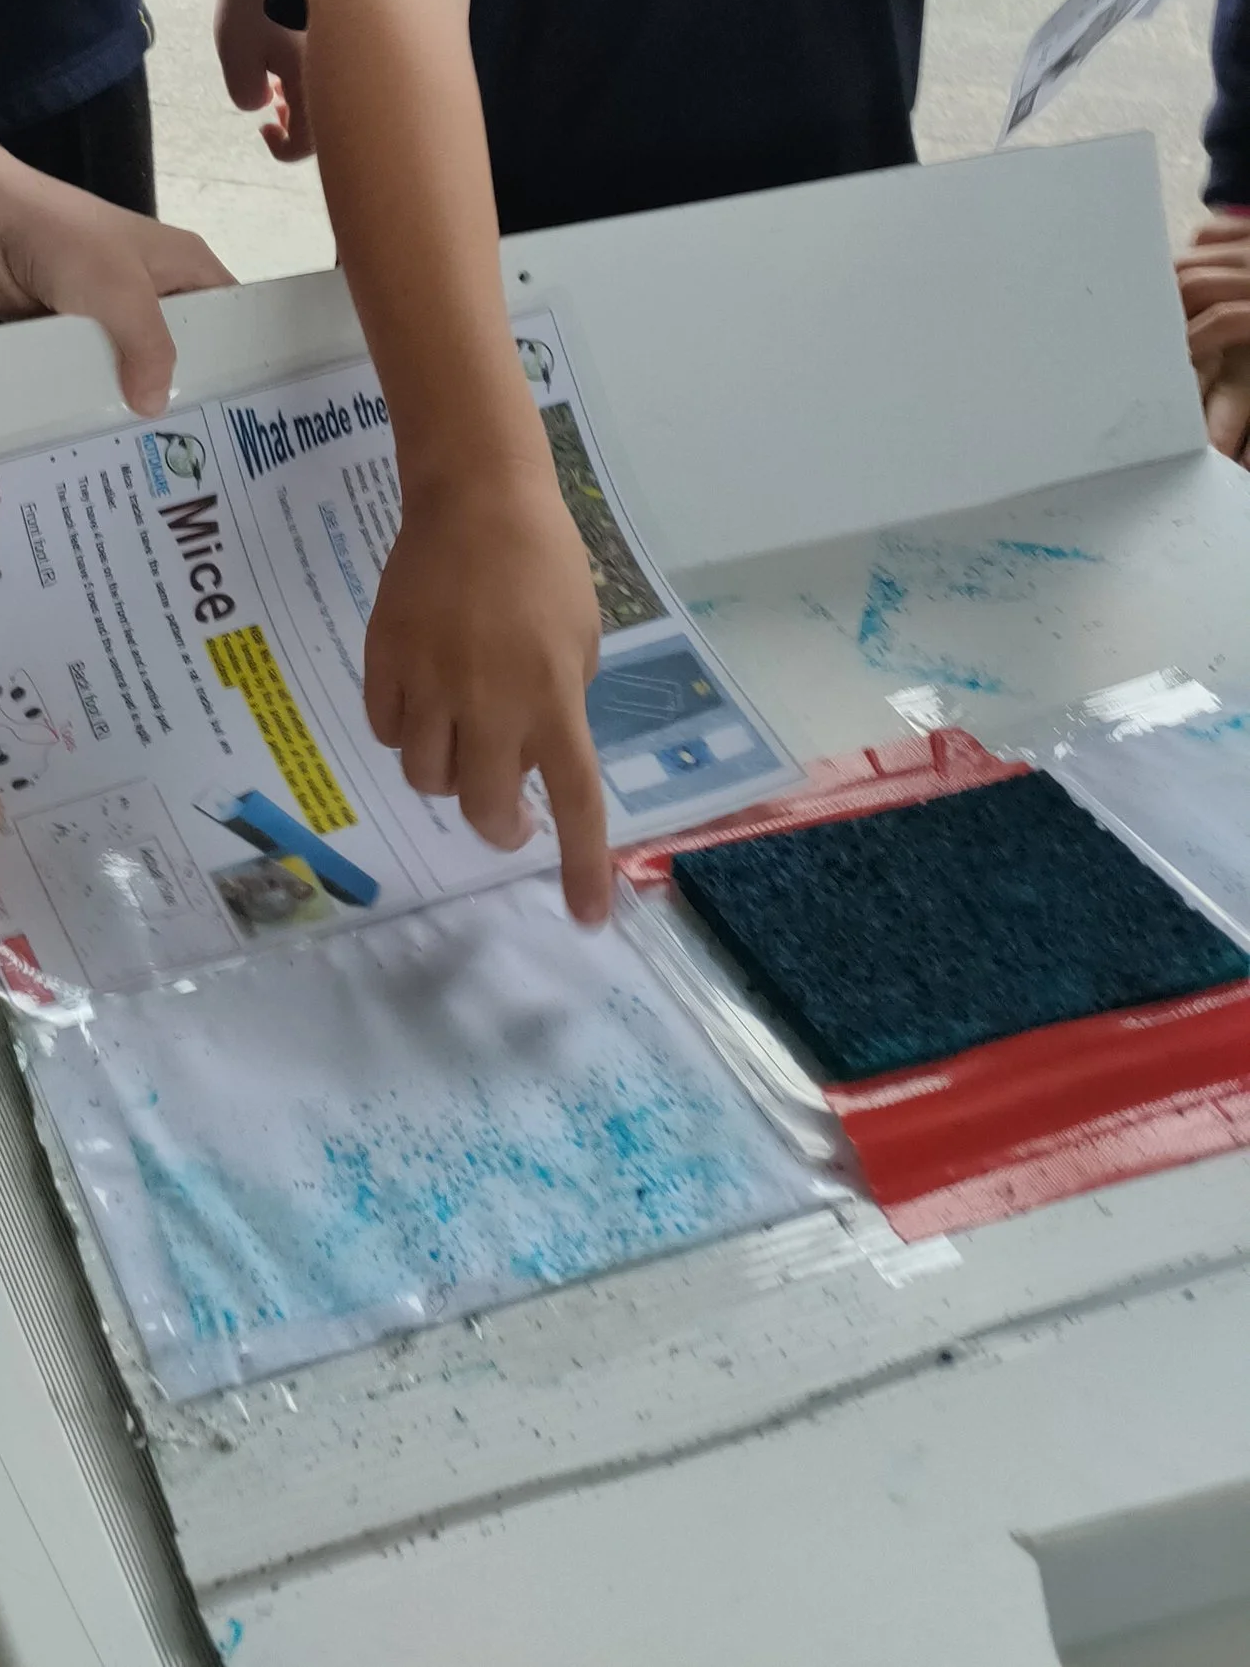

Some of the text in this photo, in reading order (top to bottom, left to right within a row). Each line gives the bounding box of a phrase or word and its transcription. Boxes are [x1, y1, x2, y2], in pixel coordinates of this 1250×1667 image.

[228, 391, 389, 481] What made the
[157, 493, 237, 624] Mice
